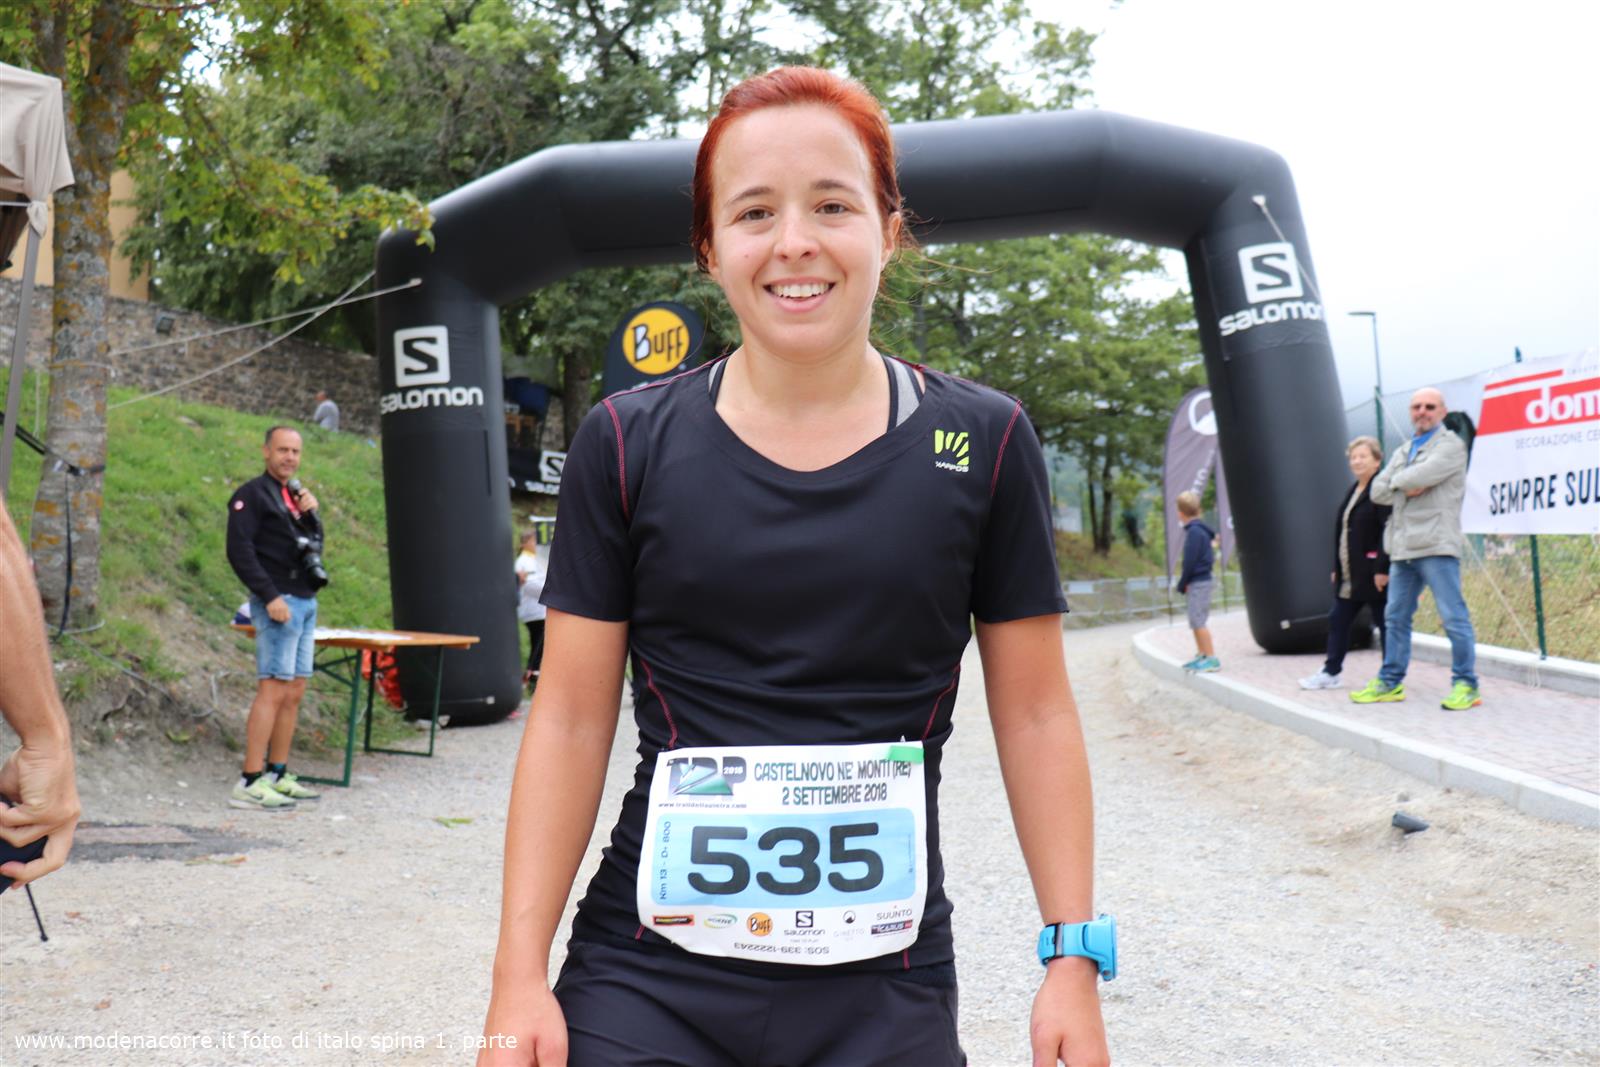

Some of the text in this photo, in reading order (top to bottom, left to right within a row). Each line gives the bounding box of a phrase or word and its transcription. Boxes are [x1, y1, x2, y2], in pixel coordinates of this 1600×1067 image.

[1490, 474, 1557, 516] SEMPRE
[754, 762, 834, 781] CASTELNOVO
[857, 759, 890, 779] MONTI
[782, 783, 887, 805] 2 SETTEMBRE 2018
[662, 821, 671, 842] 800
[687, 822, 884, 895] 535
[659, 869, 667, 879] 13
[659, 883, 667, 899] Km
[876, 909, 912, 920] SUUNTO
